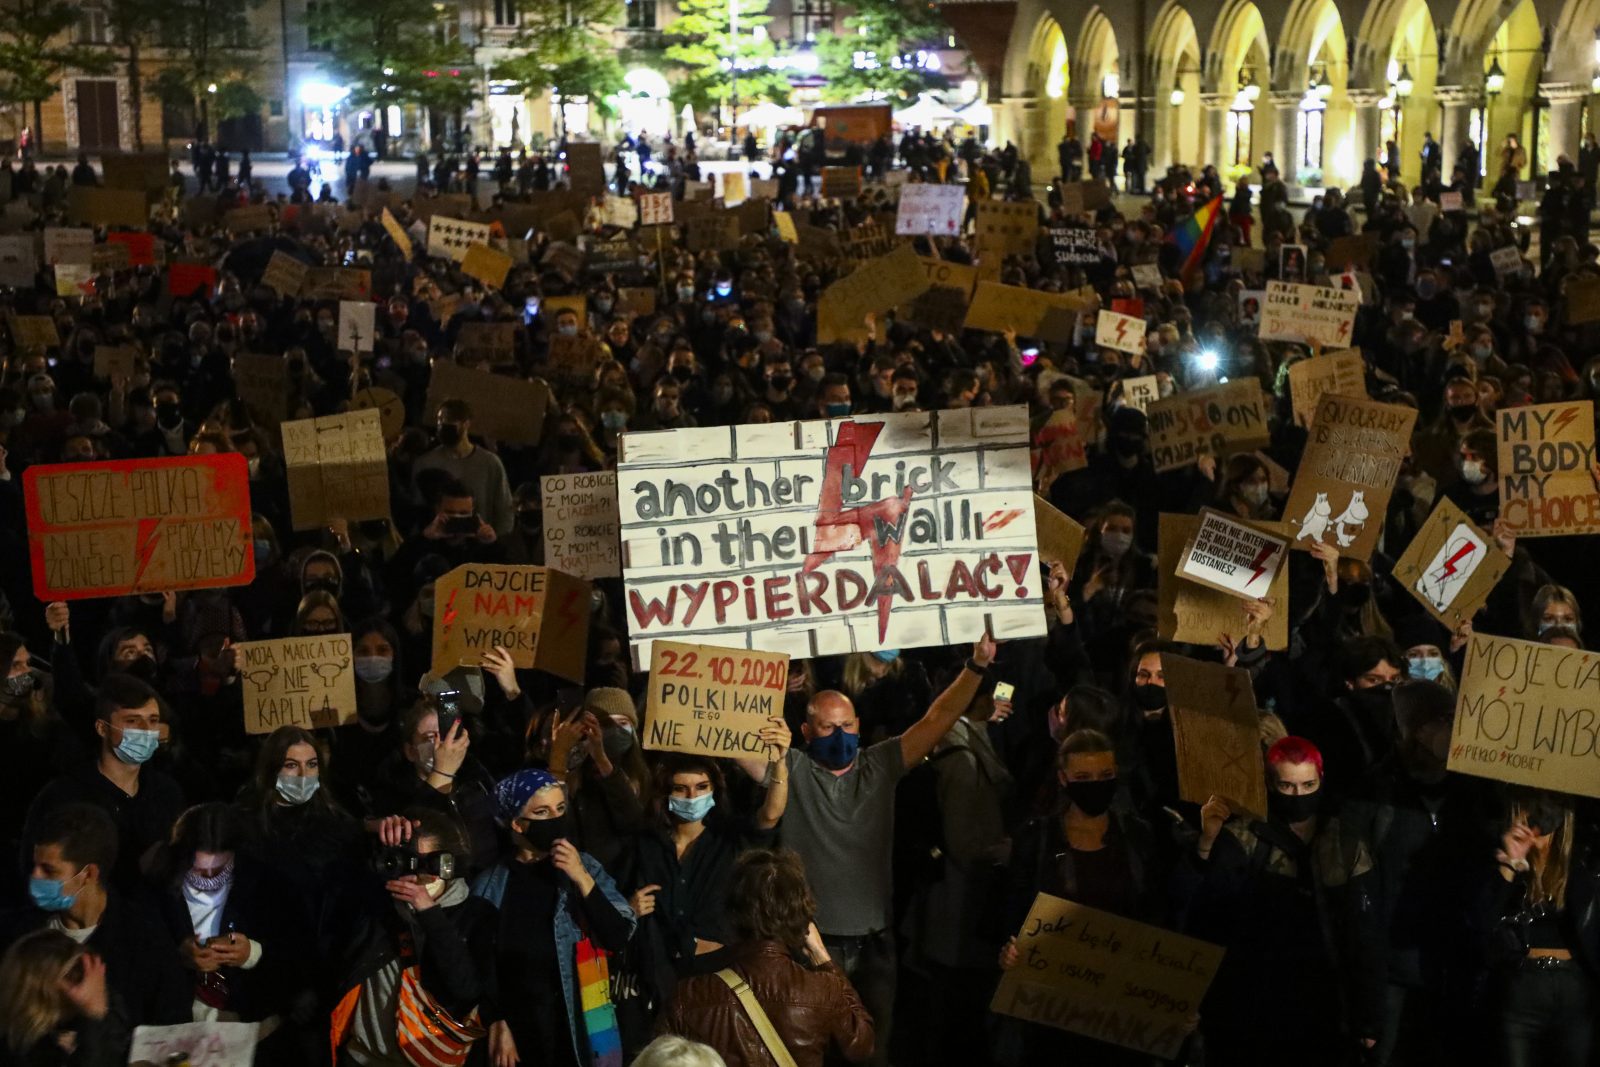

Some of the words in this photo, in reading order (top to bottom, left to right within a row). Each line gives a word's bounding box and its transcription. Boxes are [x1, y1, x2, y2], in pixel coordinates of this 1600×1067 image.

[922, 261, 951, 282] TO
[1503, 409, 1555, 442] MY
[1513, 441, 1595, 474] BODY
[41, 471, 124, 524] JESZCZE
[131, 468, 201, 517] POLKA
[546, 478, 566, 493] CO
[631, 467, 814, 520] another
[841, 456, 960, 503] brick
[1505, 474, 1552, 500] MY
[546, 497, 556, 508] Z
[561, 493, 593, 506] MOIM
[1503, 493, 1600, 529] CHOICE
[213, 520, 237, 547] MY
[547, 528, 565, 541] CO
[657, 527, 702, 566] in
[712, 519, 797, 568] the
[873, 499, 971, 546] wall
[1200, 529, 1212, 541] SIĘ
[1205, 517, 1229, 534] JAREK
[1229, 526, 1242, 539] NIE
[51, 532, 100, 557] NIE
[553, 545, 563, 557] Z
[568, 541, 600, 555] MOIM
[1196, 541, 1207, 552] BO
[174, 544, 247, 580] IDZIEMY
[1191, 551, 1237, 576] DOSTANIESZ
[465, 571, 545, 592] DAJCIE
[474, 592, 534, 617] NAM
[464, 625, 537, 650] WYBÓR!
[246, 646, 276, 667] MOJA
[283, 642, 326, 662] MACICA
[328, 639, 349, 656] TO
[1468, 637, 1552, 694] MOJE
[284, 665, 309, 689] NIE
[257, 694, 332, 727] KAPLICA
[661, 683, 725, 711] POLKI
[734, 691, 772, 715] WAM
[692, 710, 720, 720] TEGO
[1459, 686, 1525, 750] MÓJ
[651, 720, 684, 746] NIE
[1506, 752, 1545, 772] KOBIET
[1027, 945, 1048, 970] to
